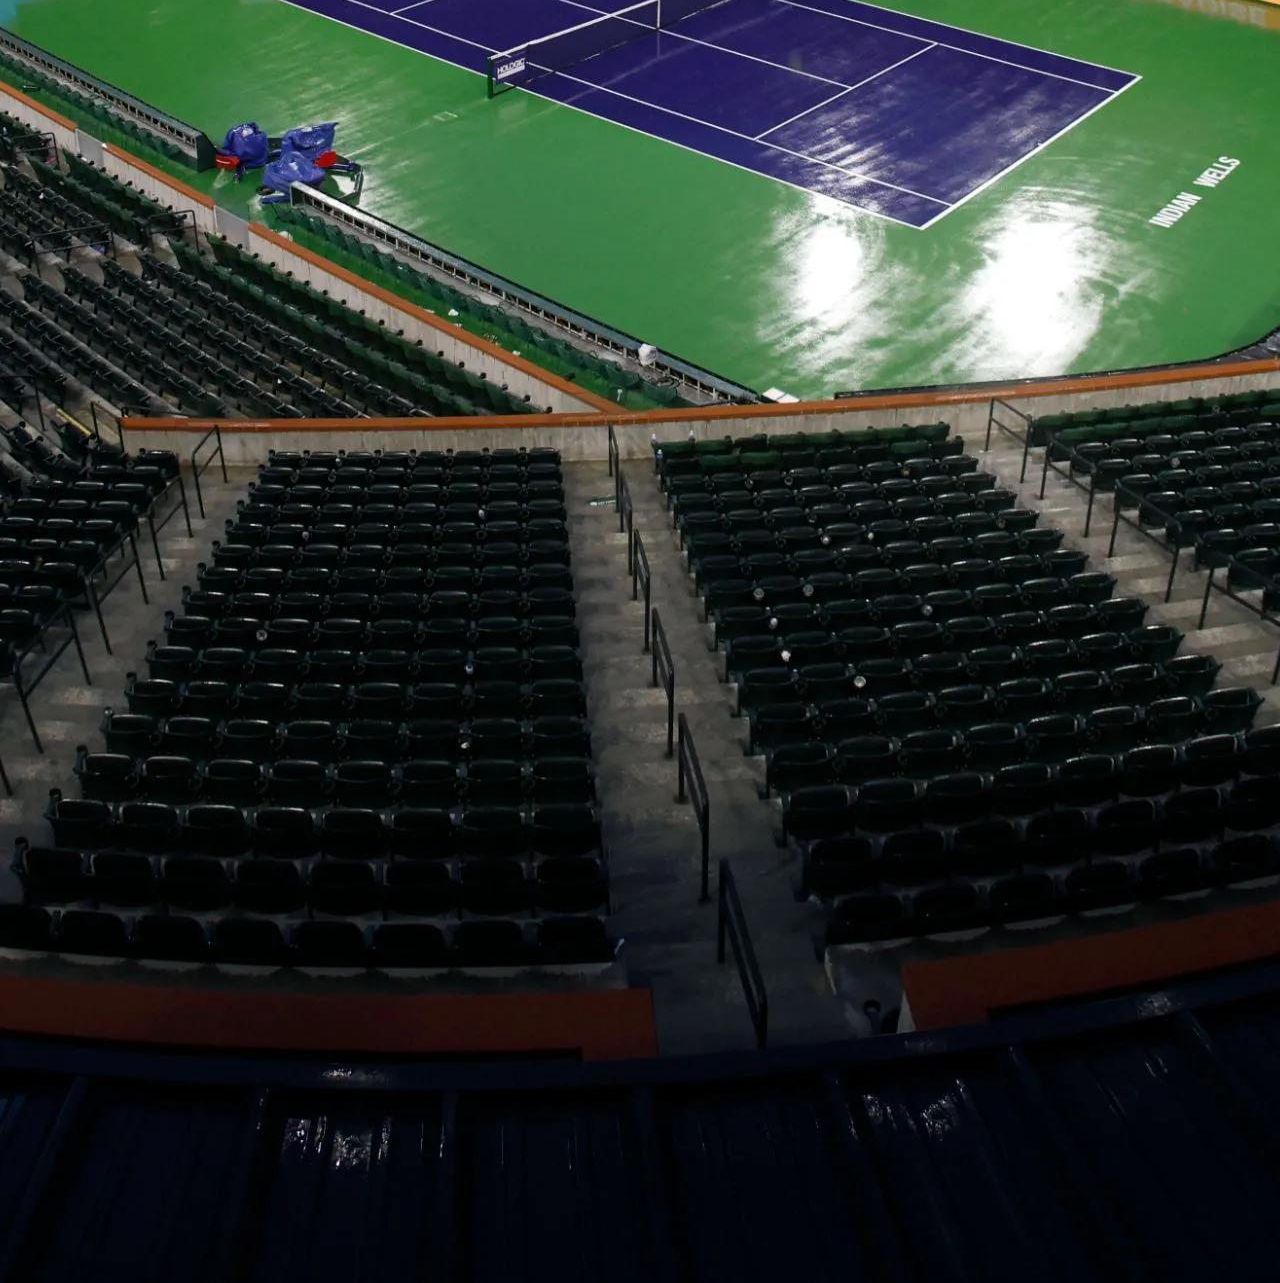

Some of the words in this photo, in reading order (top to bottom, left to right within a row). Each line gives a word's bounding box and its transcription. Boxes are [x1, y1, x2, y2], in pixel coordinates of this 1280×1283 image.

[497, 58, 525, 76] HOLOGIC
[1148, 191, 1202, 228] INDIAN
[1193, 156, 1241, 188] WELLS
